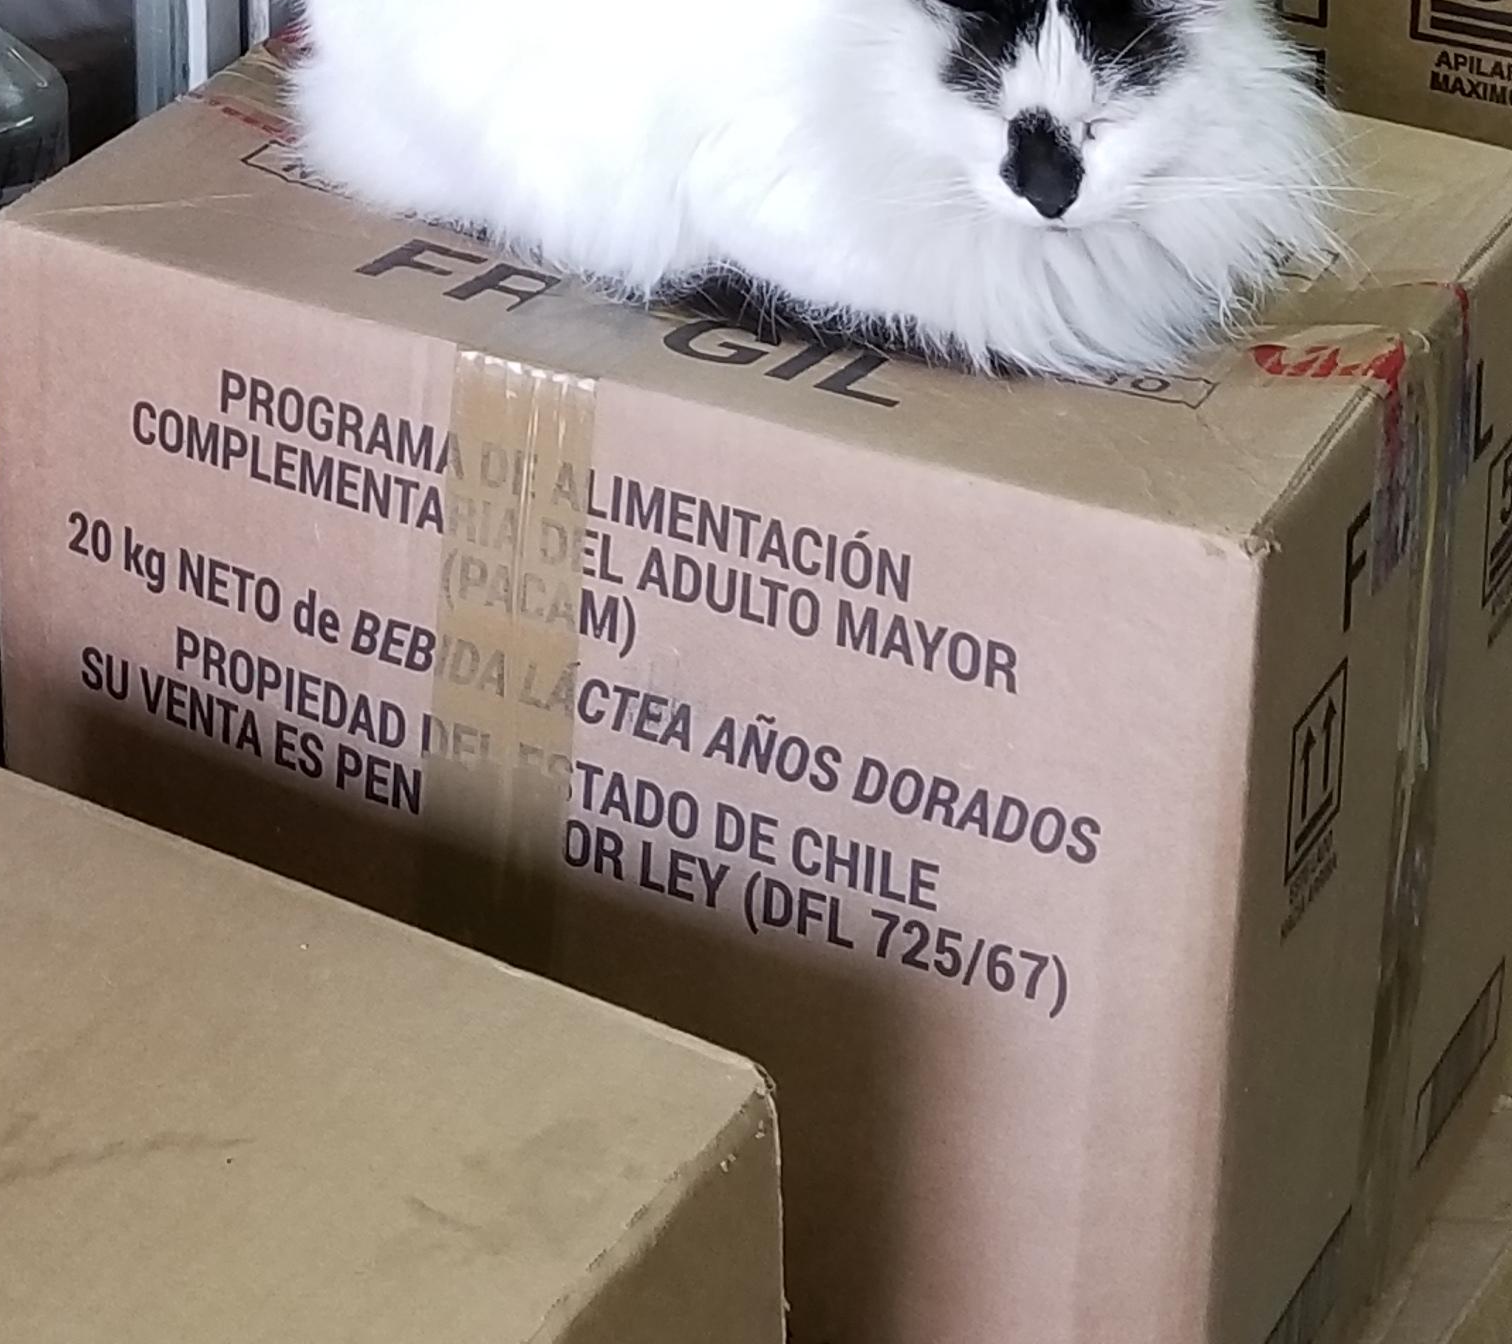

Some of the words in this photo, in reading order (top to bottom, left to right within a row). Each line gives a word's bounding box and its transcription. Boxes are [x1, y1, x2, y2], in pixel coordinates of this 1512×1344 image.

[354, 238, 901, 409] FRGIL
[131, 400, 519, 555] COMPLEMENTARIA
[637, 547, 820, 638] ADULTO
[836, 598, 1019, 695] MAYOR
[220, 368, 465, 481] PROGRAMA
[549, 460, 912, 602] ALIMENTACIÓN
[442, 550, 638, 659] (PACAM)
[67, 510, 112, 563] 20
[123, 525, 166, 594] kg
[179, 548, 282, 624] NETO
[293, 588, 341, 644] de
[350, 608, 508, 698] BEBIDA
[523, 658, 693, 753] LÁCTEA
[702, 712, 842, 793] AÑOS
[852, 755, 1102, 865] DORADOS
[175, 625, 407, 751] PROPIEDAD
[714, 801, 779, 866] DE
[790, 825, 941, 913] CHILE
[80, 646, 130, 701] SU
[139, 665, 264, 759] VENTA
[273, 724, 324, 780] ES
[638, 840, 731, 910] LEY
[743, 871, 855, 951] (DFL
[870, 908, 1069, 1019] 725/67)
